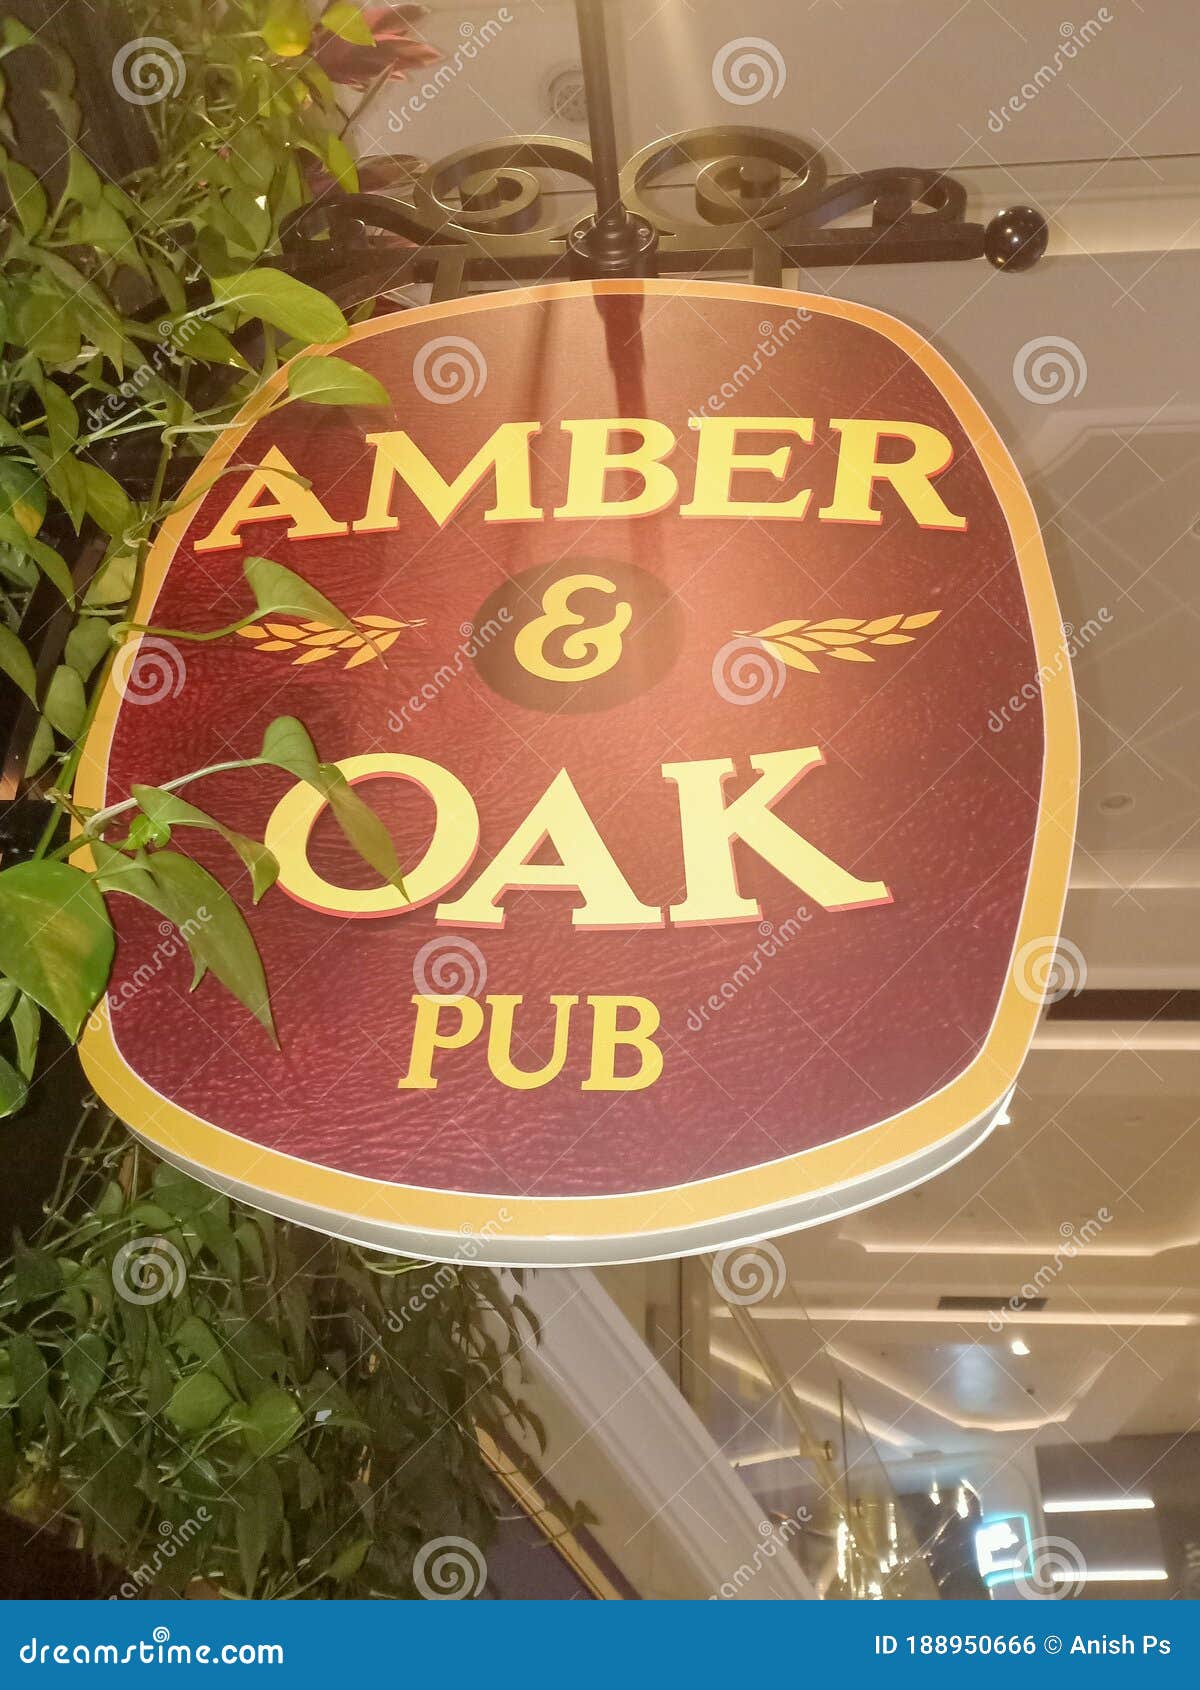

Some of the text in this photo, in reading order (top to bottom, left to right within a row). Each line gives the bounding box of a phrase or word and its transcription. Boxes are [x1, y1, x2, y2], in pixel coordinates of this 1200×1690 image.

[194, 417, 967, 552] AMBER
[515, 574, 632, 682] &
[264, 746, 893, 930] OAK
[398, 994, 663, 1091] PUB
